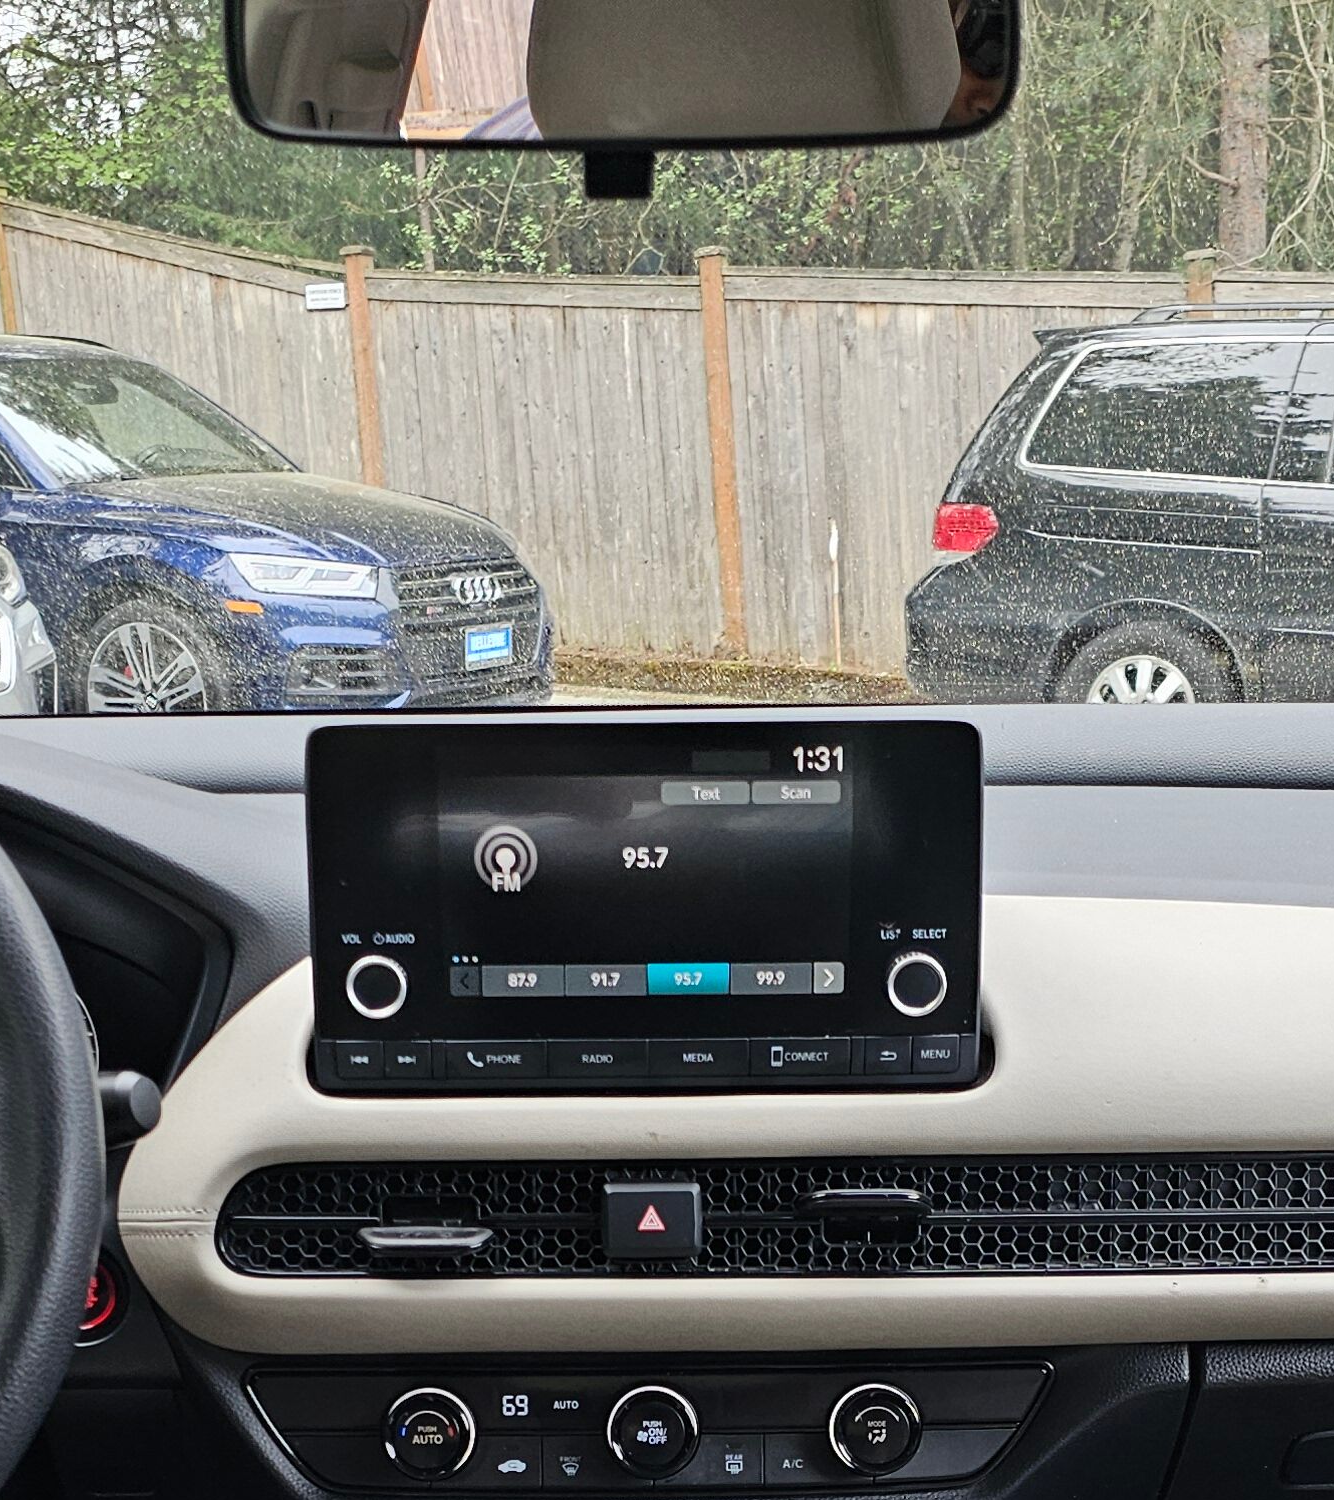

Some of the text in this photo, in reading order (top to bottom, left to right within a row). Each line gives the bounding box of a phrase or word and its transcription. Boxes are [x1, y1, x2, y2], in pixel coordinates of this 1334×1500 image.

[793, 746, 844, 772] 1:31
[692, 786, 720, 800] Text
[780, 786, 812, 800] Scan
[622, 847, 668, 869] 95.7
[492, 872, 521, 892] FM
[341, 933, 415, 944] VOL AUDIO
[912, 929, 947, 939] SELECT
[507, 973, 537, 988] 87.9
[590, 972, 620, 987] 91.7
[674, 971, 703, 987] 95.7
[756, 971, 785, 986] 99.9
[486, 1054, 522, 1064] PHONE
[582, 1053, 613, 1064] RADIO
[683, 1053, 714, 1063] MEDIA
[784, 1051, 829, 1062] CONNECT
[920, 1050, 951, 1060] MENU
[502, 1395, 529, 1417] 69
[553, 1400, 579, 1410] AUTO
[648, 1428, 667, 1437] ON/
[412, 1434, 443, 1445] AUTO
[648, 1436, 667, 1445] OFF
[782, 1459, 803, 1469] A/C
